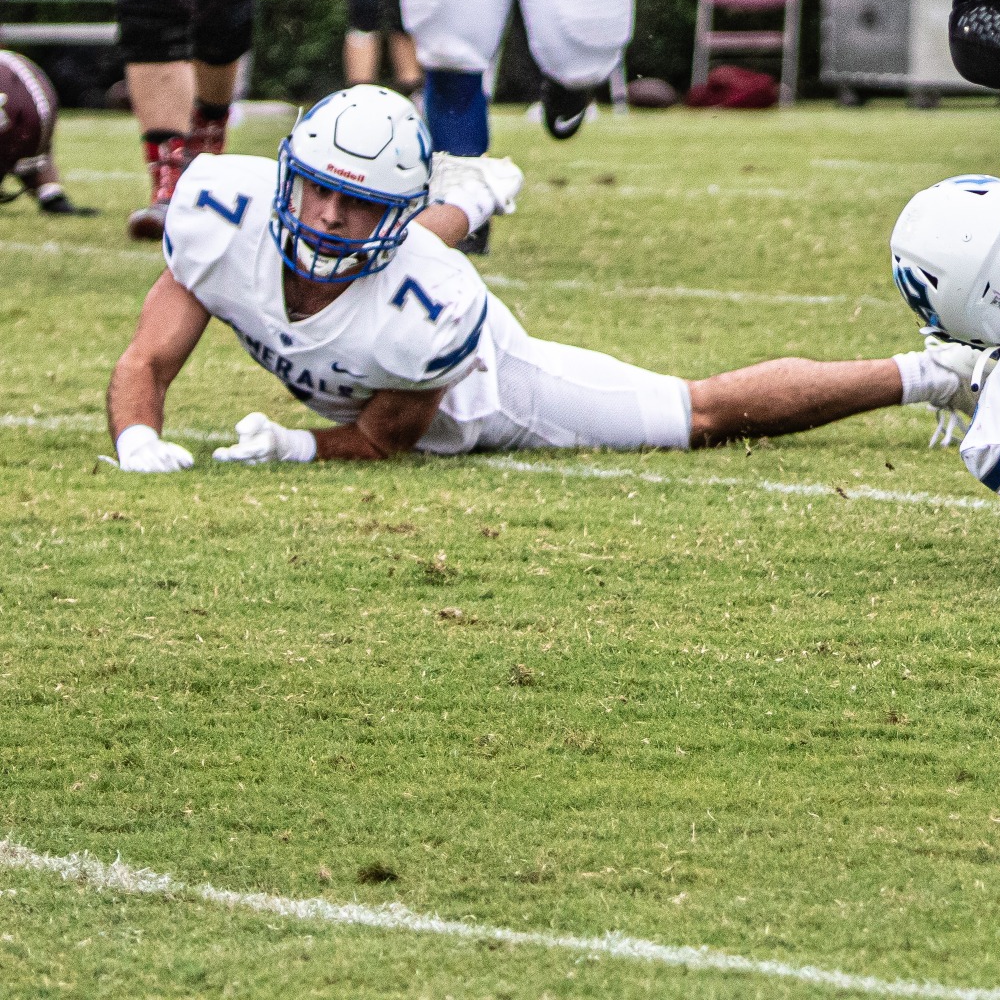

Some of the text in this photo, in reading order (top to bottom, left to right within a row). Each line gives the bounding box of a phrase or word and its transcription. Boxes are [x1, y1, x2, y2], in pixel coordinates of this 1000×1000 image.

[326, 163, 366, 183] Riddell
[194, 188, 252, 230] 7
[388, 274, 445, 326] 7
